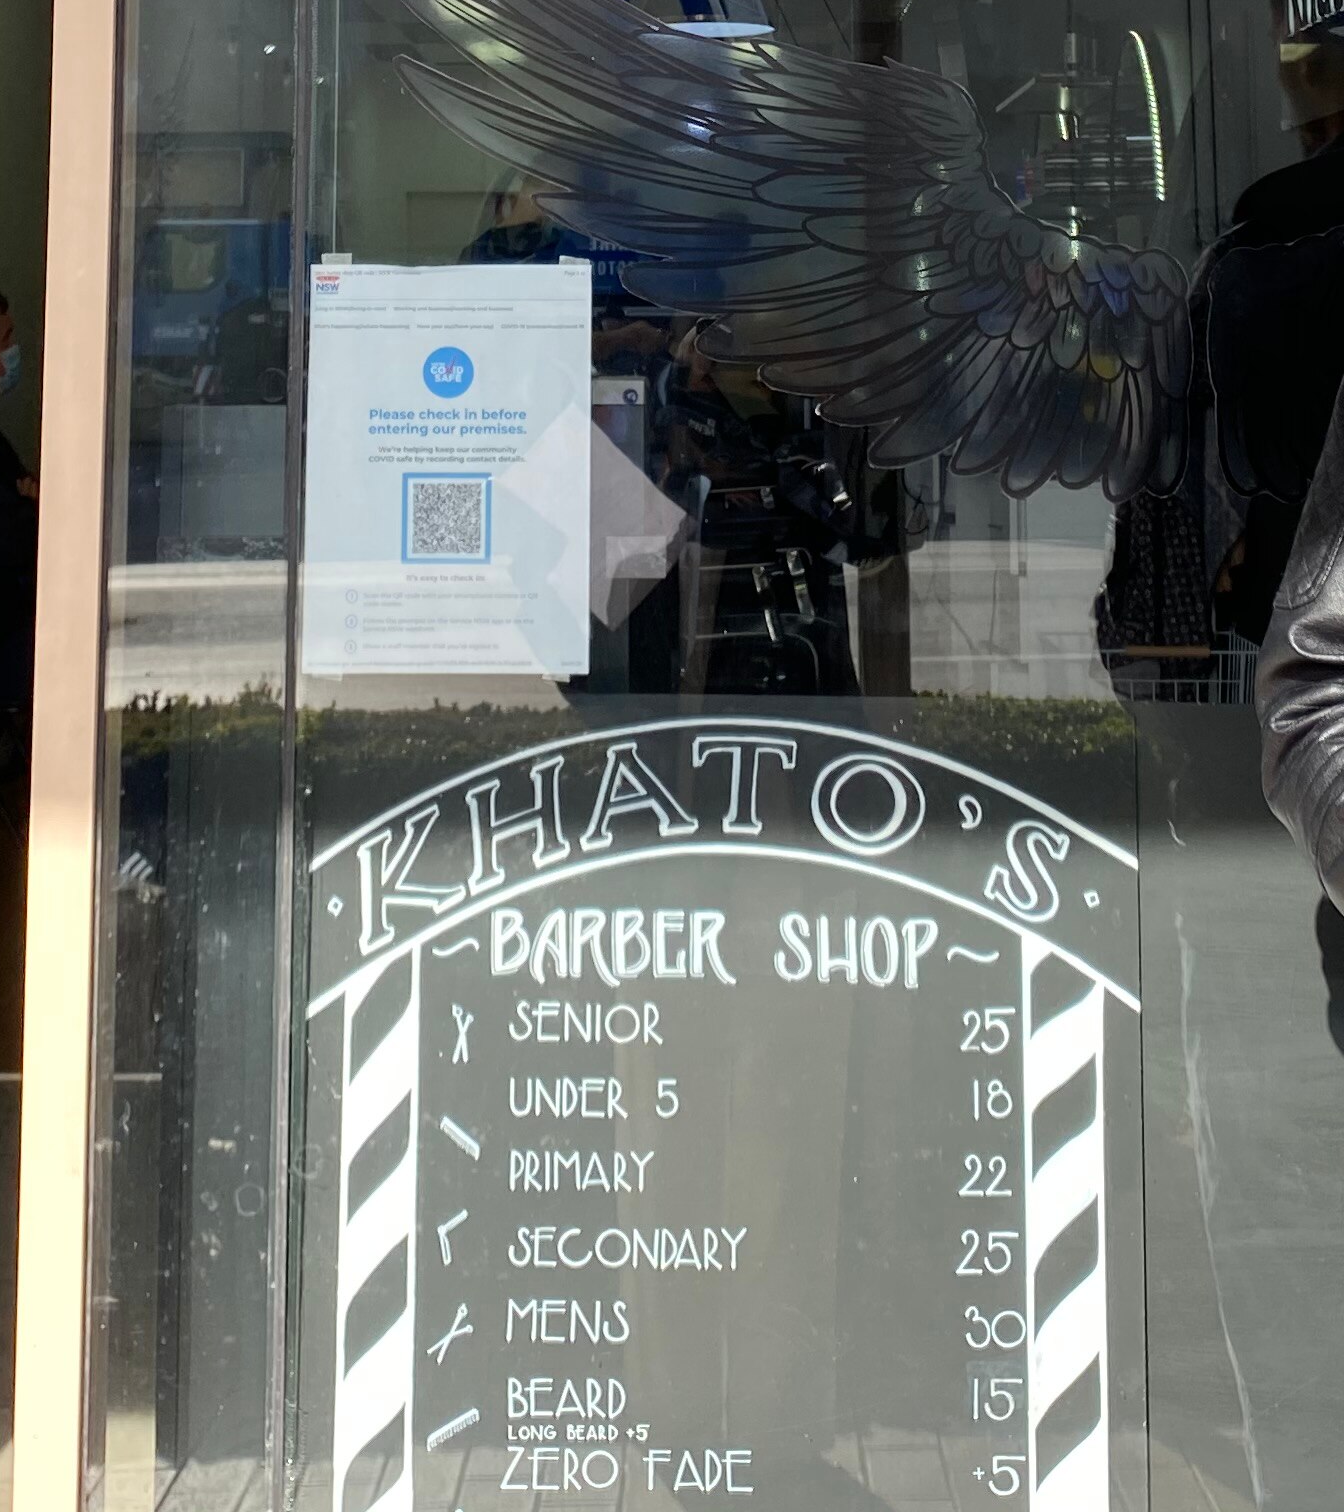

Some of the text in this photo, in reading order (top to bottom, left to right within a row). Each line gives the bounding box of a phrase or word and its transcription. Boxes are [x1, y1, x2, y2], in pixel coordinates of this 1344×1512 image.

[315, 282, 340, 292] NSW
[434, 374, 462, 383] SAFE
[368, 423, 527, 437] entering our premises.
[369, 408, 527, 420] Please check in before
[368, 455, 395, 463] COVID
[396, 455, 413, 463] safe
[426, 455, 465, 465] recording
[466, 455, 496, 463] contact
[403, 446, 433, 455] helping
[435, 446, 455, 455] keep
[358, 735, 1071, 955] KHATO'S
[489, 908, 939, 988] BARBER SHOP
[508, 1000, 1015, 1055] SENIOR 25
[508, 1079, 1014, 1119] UNDER 5 18
[508, 1150, 1013, 1198] PRIMARY 22
[508, 1225, 1020, 1276] SECONDARY 25
[506, 1299, 1027, 1350] MENS 30
[507, 1376, 1024, 1422] BEARD 15
[507, 1424, 650, 1442] LONG BEARD +5
[500, 1446, 1027, 1496] ZERO FADE +5
